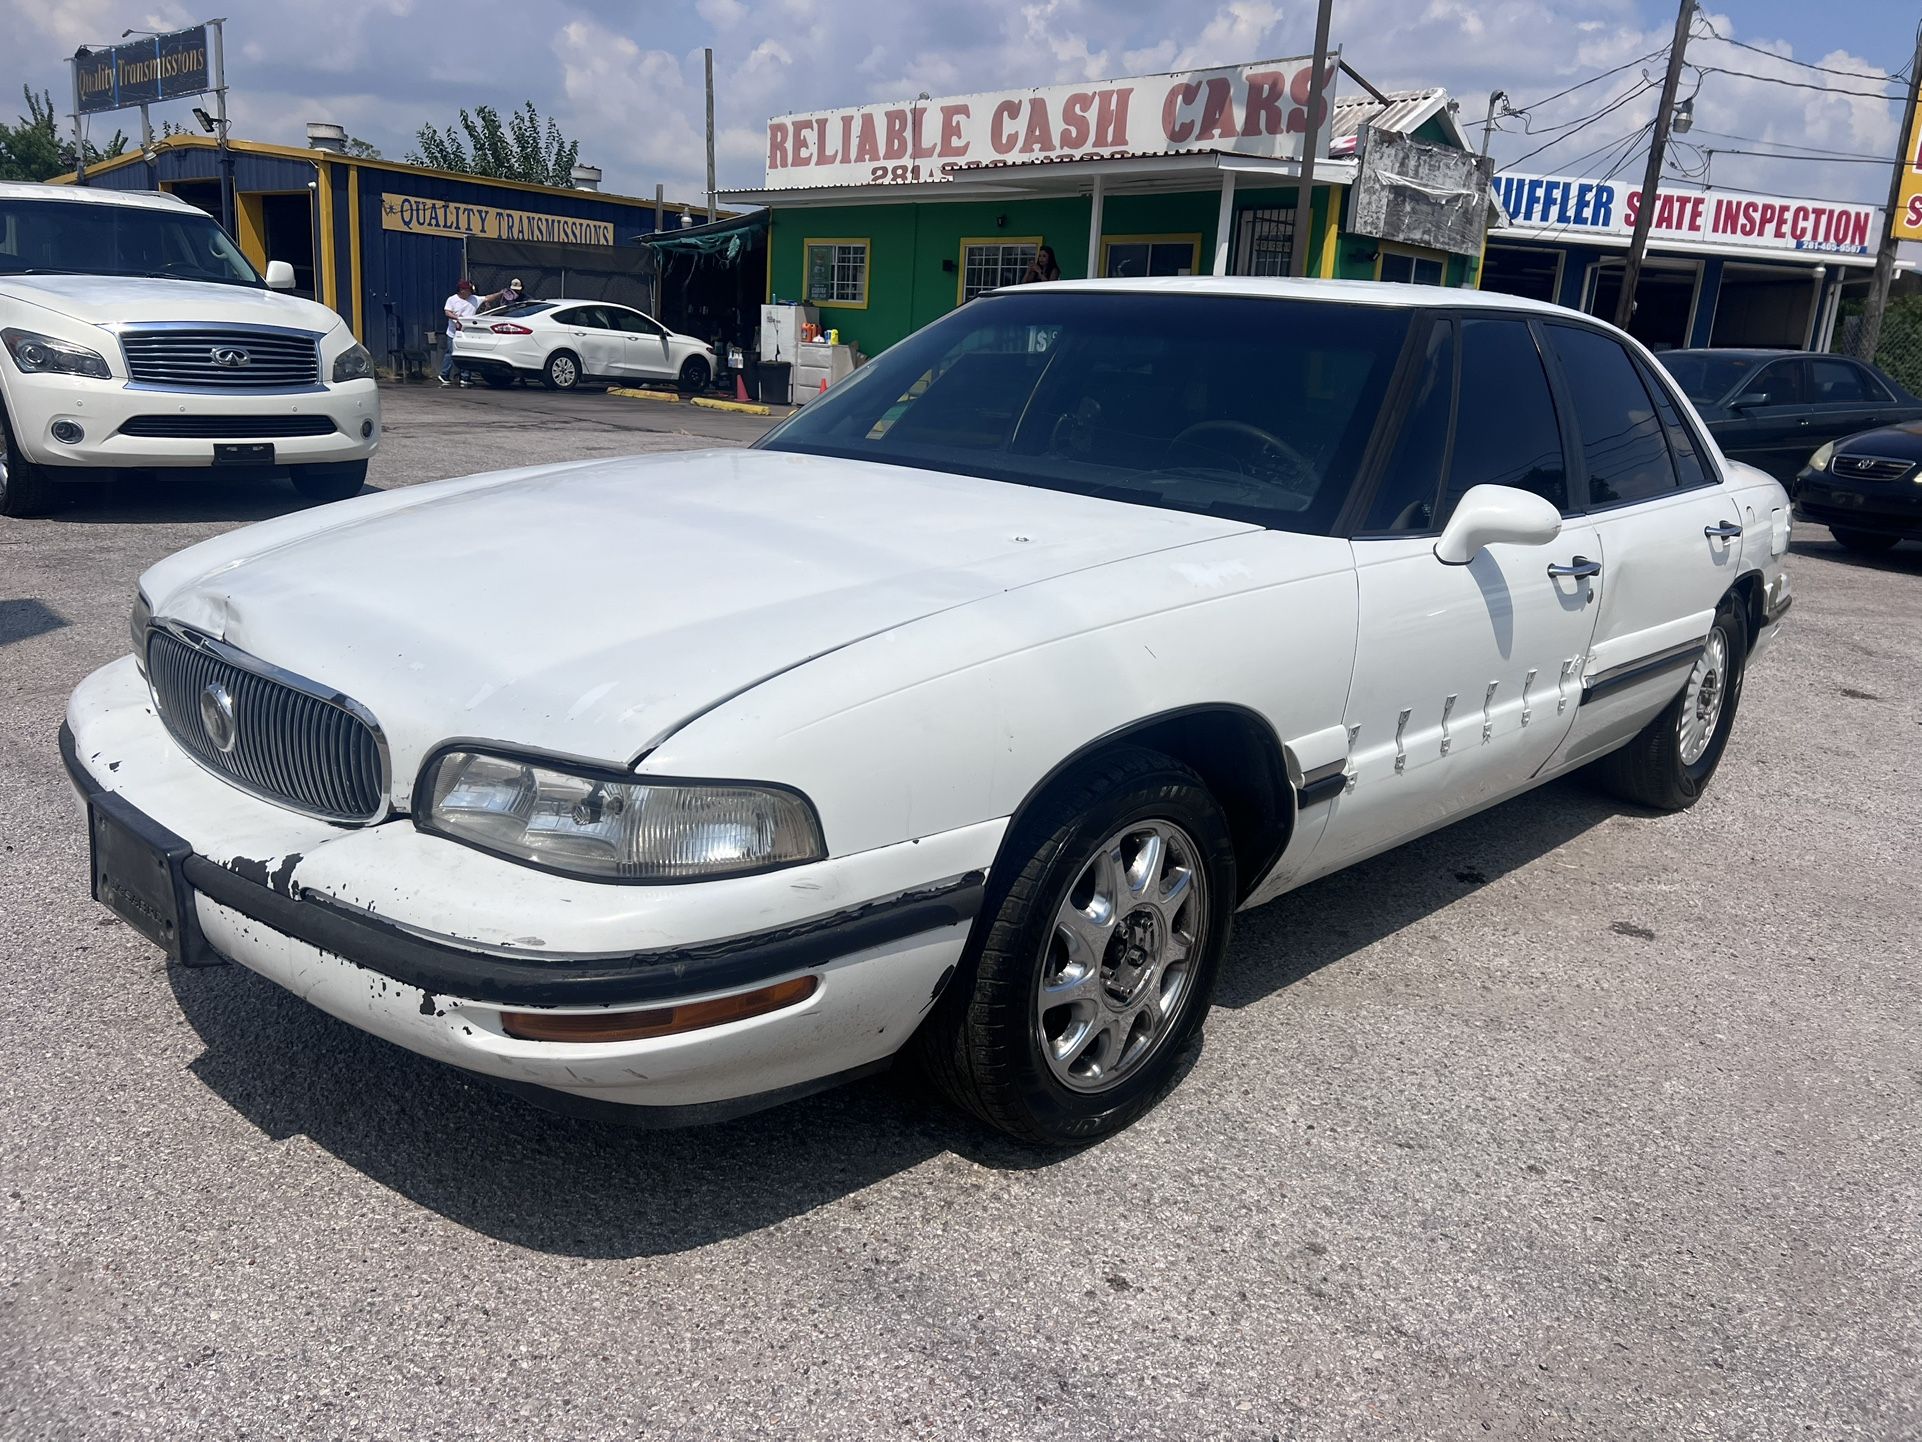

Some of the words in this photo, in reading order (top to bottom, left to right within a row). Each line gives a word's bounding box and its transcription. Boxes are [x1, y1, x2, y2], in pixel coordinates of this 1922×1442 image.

[78, 64, 116, 101] Quality
[118, 48, 204, 86] Transmissions
[768, 103, 972, 170] RELIABLE
[990, 87, 1135, 156] CASH
[1161, 65, 1336, 144] CARS
[400, 197, 490, 234] QUALITY
[495, 211, 610, 246] TRANSMISSIONS
[1711, 198, 1871, 247] INSPECTION
